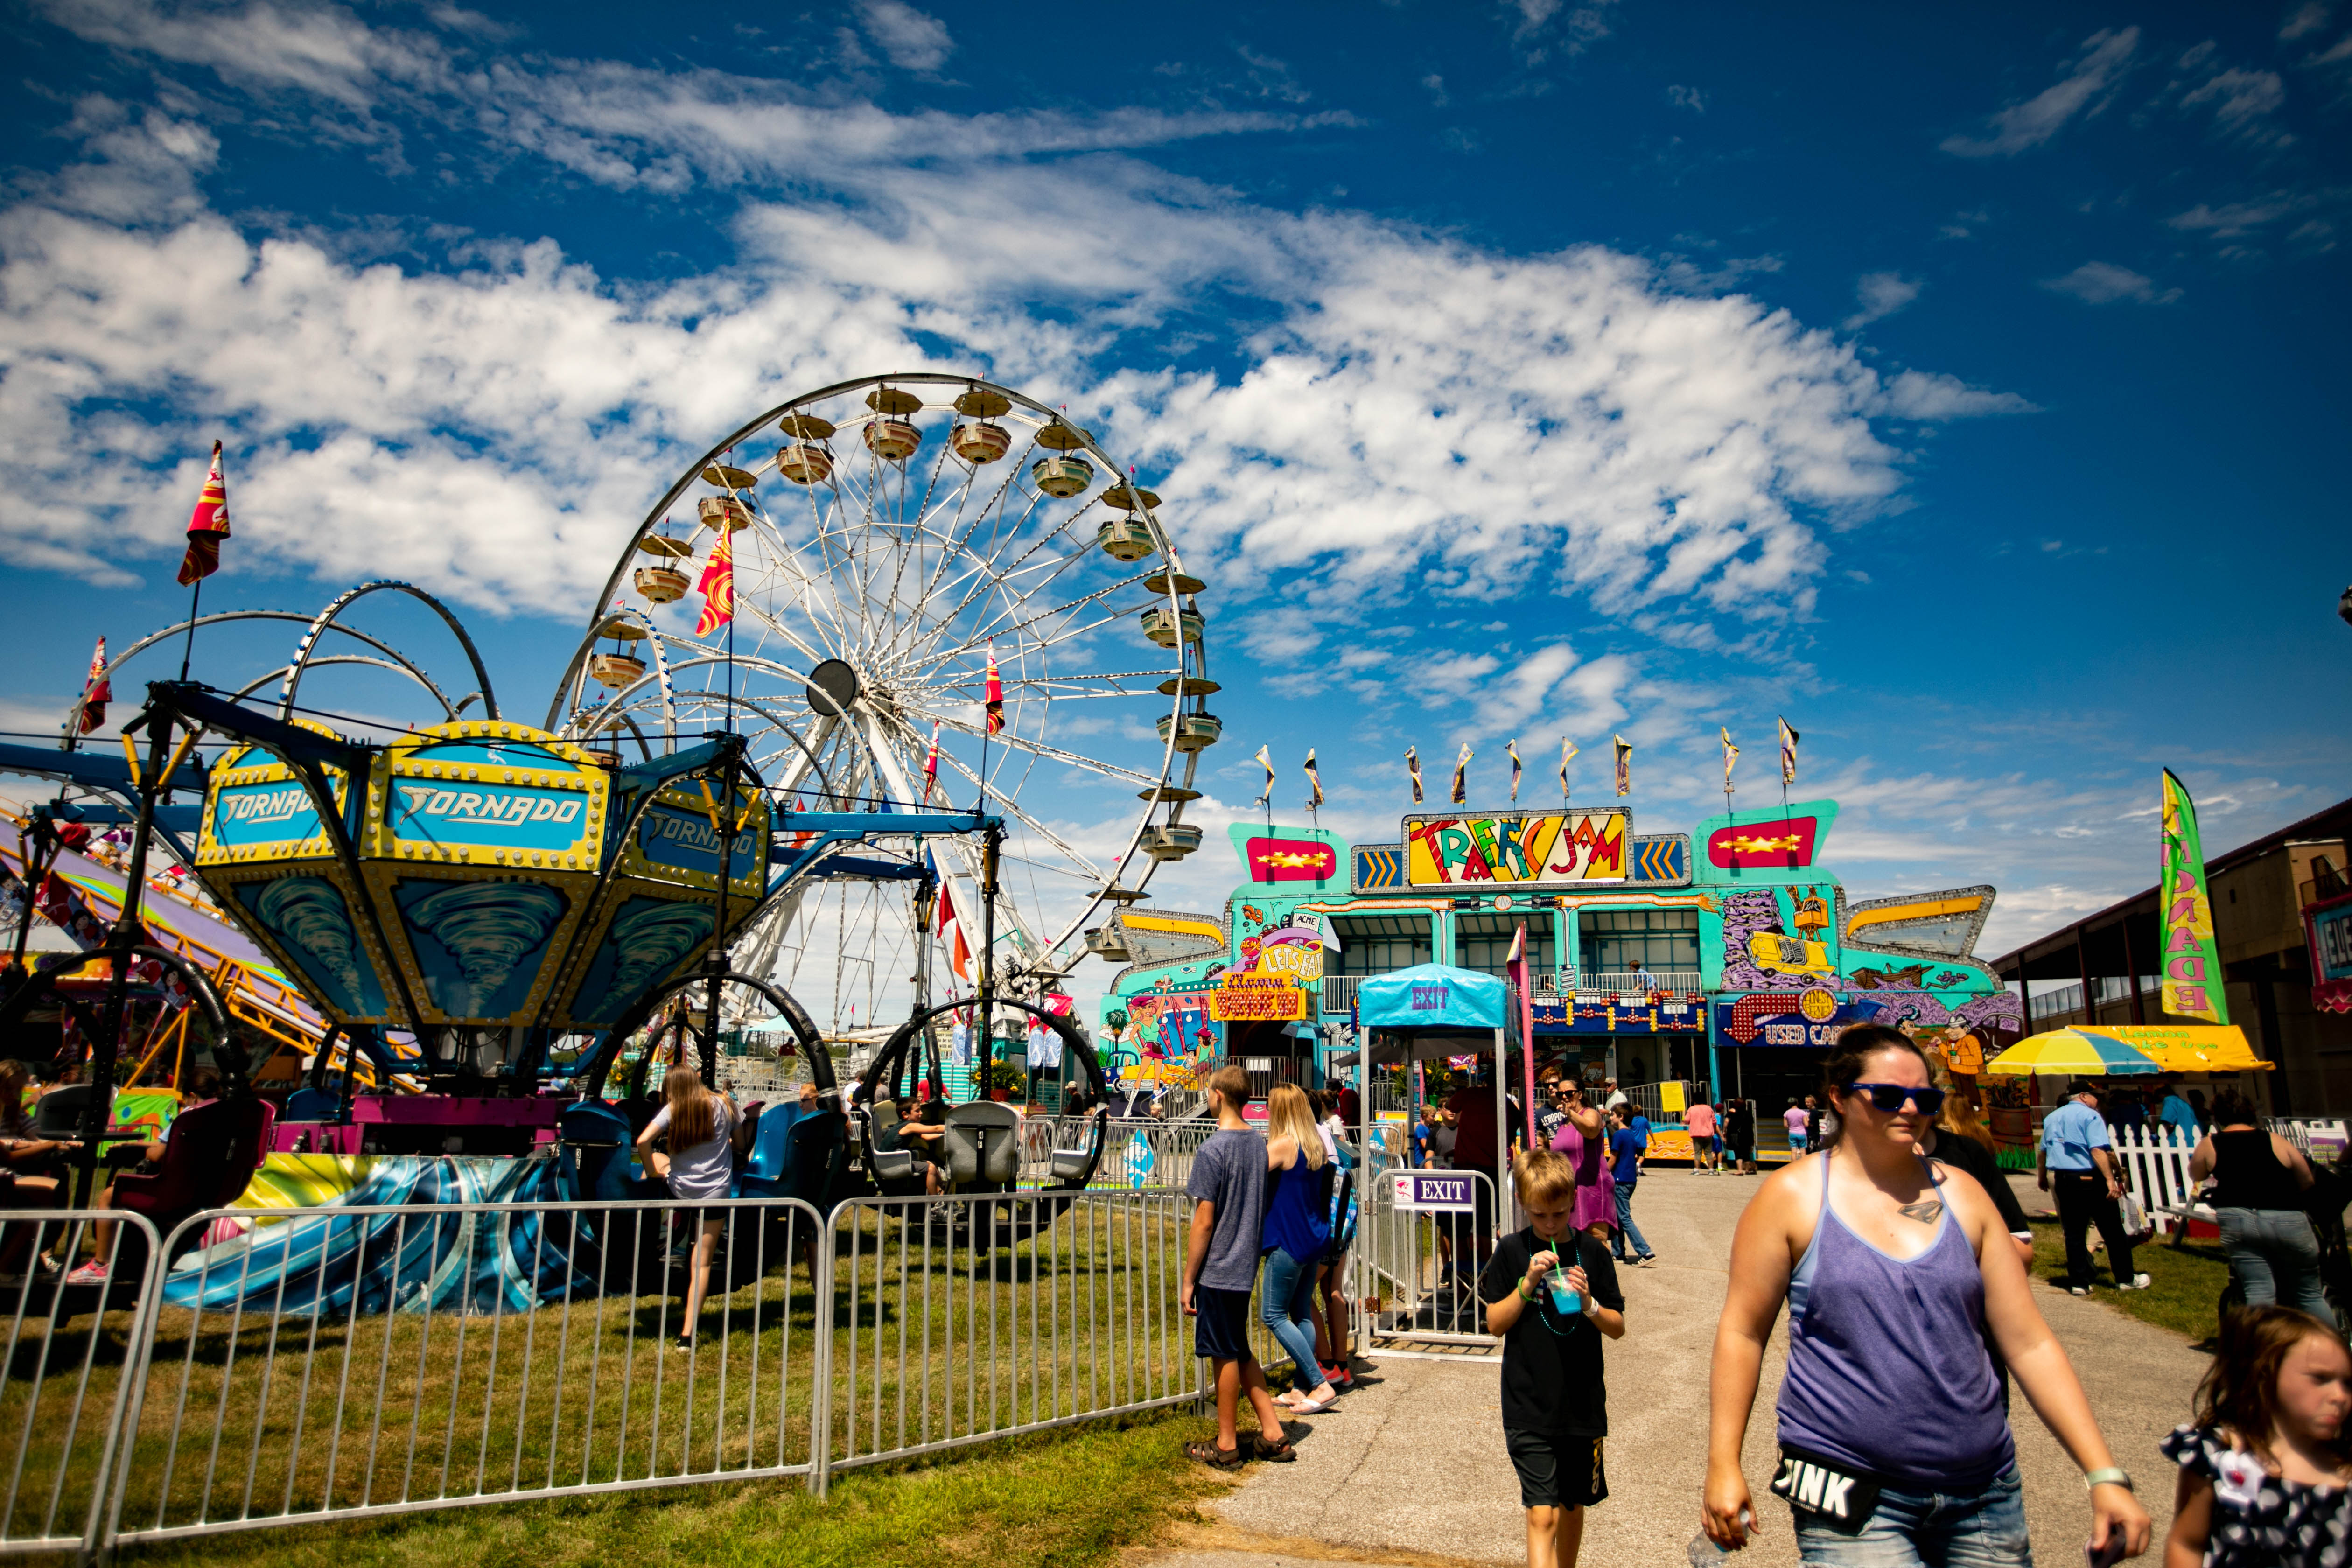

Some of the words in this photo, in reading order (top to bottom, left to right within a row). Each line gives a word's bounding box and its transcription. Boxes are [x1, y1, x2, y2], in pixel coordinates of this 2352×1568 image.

[221, 789, 316, 829] TORNAD
[399, 786, 582, 826] TORNADO
[1550, 816, 1622, 874] JAM
[1297, 915, 1316, 926] ACME
[1264, 947, 1300, 973] LET'S
[1299, 952, 1322, 977] EAT
[1215, 990, 1277, 1018] DRIVE
[1412, 987, 1449, 1010] EXIT
[1765, 1025, 1805, 1044] USED
[1809, 1025, 1846, 1045] CAR
[2119, 1029, 2190, 1038] Lemon
[2127, 1040, 2168, 1050] ake
[1421, 1181, 1464, 1200] EXIT
